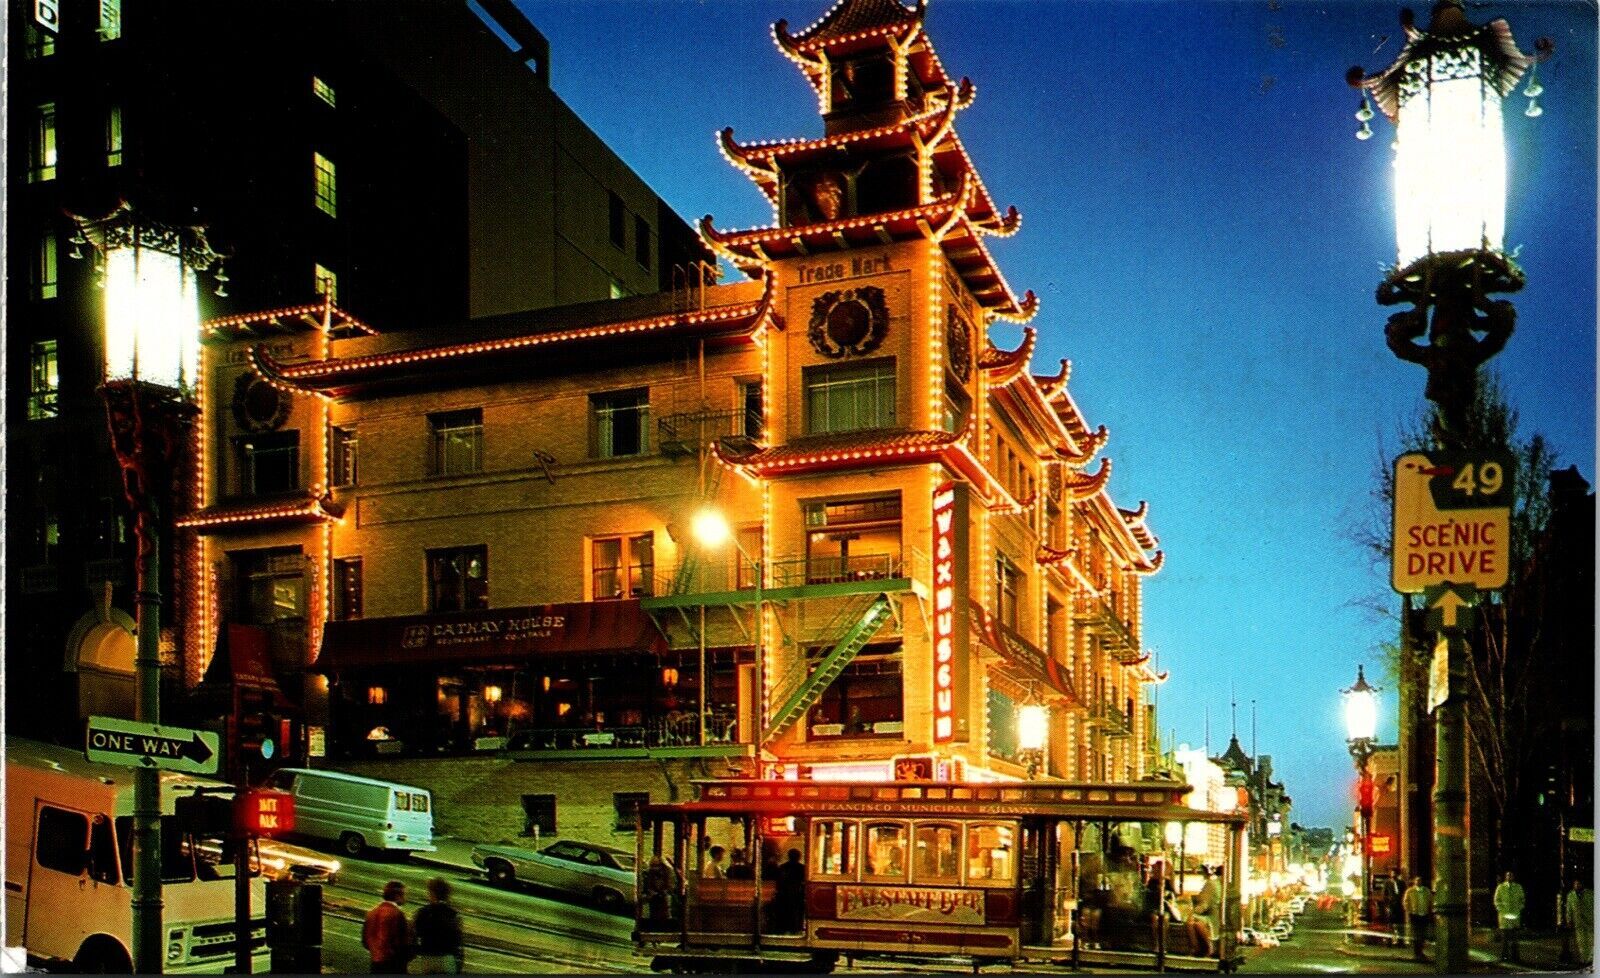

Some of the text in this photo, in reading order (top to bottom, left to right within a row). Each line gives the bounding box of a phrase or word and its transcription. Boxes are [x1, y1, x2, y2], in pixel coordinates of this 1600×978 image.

[1453, 462, 1504, 496] 49
[1408, 521, 1497, 548] SCENIC
[1407, 550, 1496, 576] DRIVE
[432, 615, 566, 636] CATHAY HOUSE
[93, 733, 182, 756] ONE WAY
[790, 802, 1037, 815] SAN FRANCISCO MUNICIPAL RAILWAY
